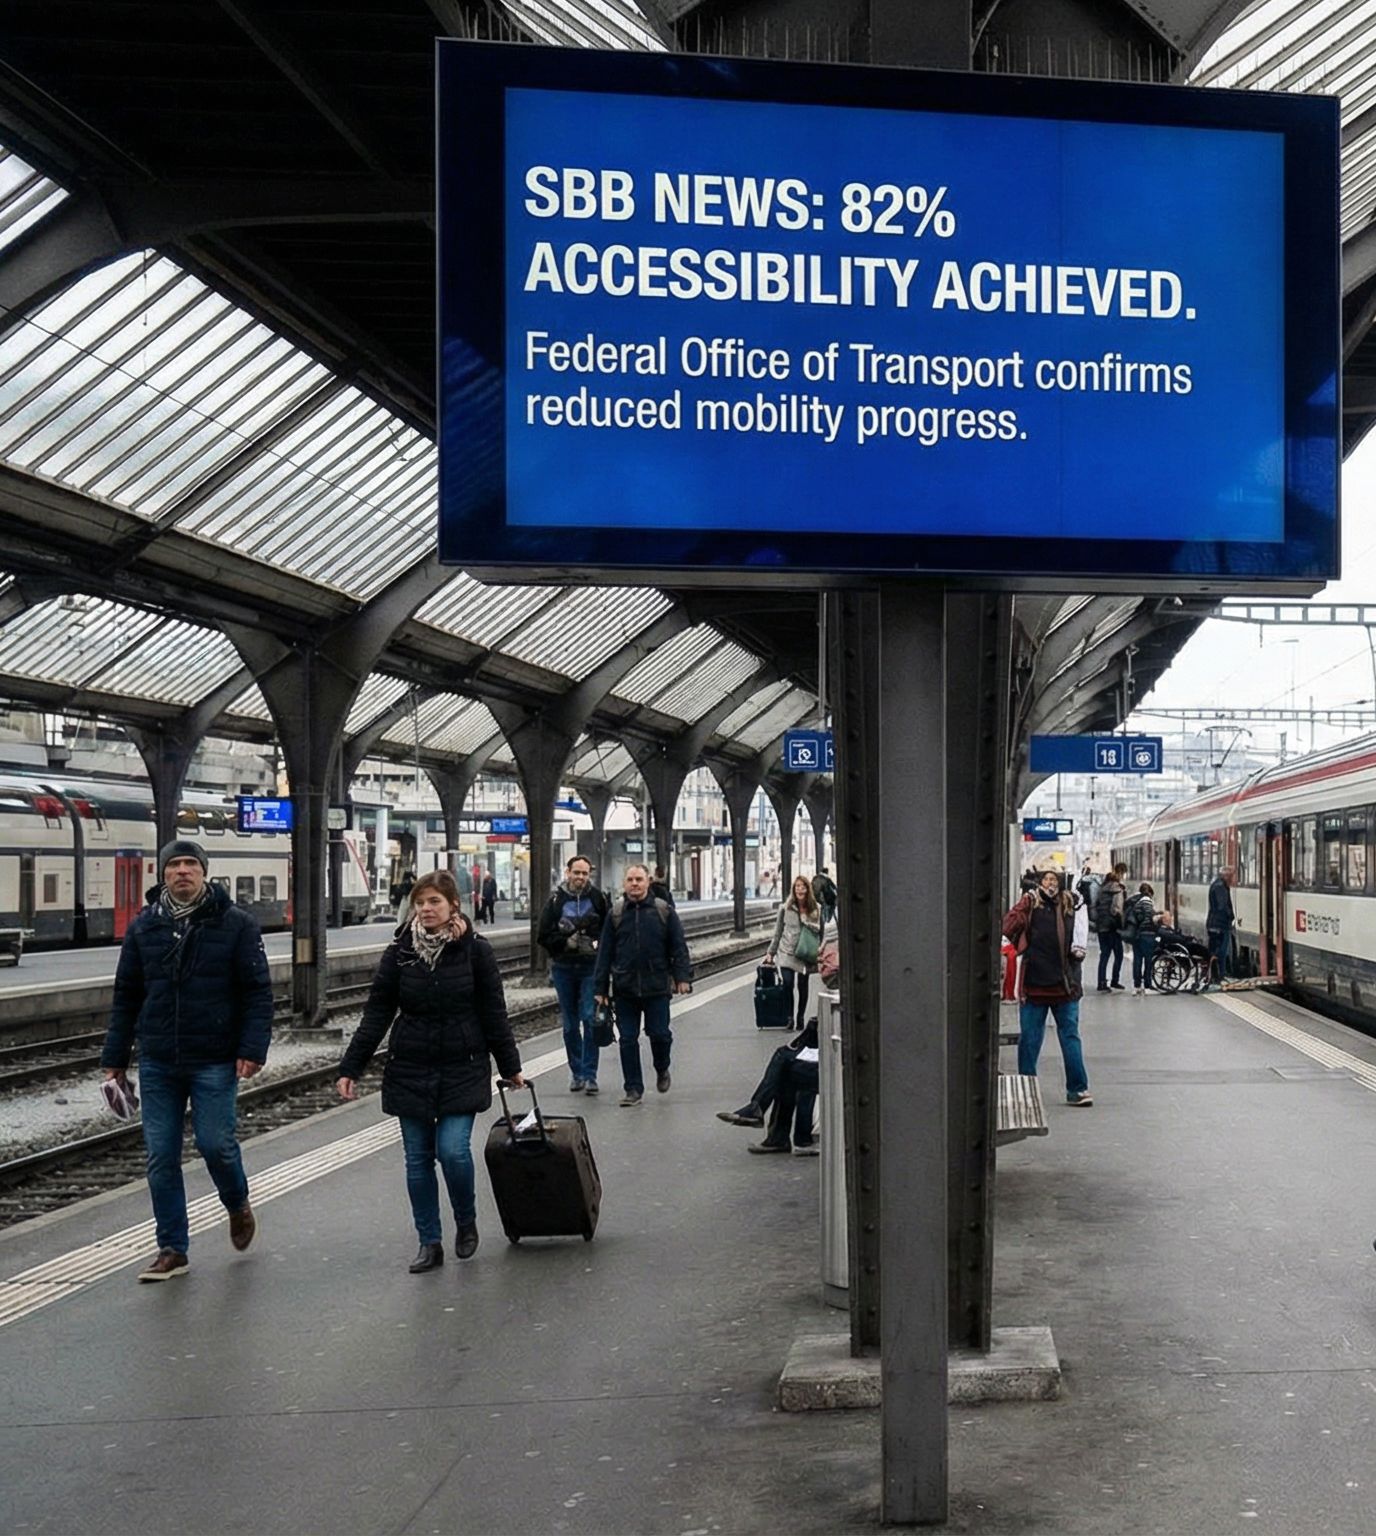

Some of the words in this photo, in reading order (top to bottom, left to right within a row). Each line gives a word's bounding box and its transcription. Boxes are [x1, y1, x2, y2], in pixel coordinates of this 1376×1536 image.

[525, 166, 634, 220] SBB
[655, 173, 823, 230] NEWS:
[841, 183, 955, 237] 82%
[525, 243, 919, 308] ACCESSIBILITY
[933, 262, 1196, 319] ACHIEVED.
[526, 331, 666, 375] Federal
[681, 337, 790, 380] Office
[803, 343, 840, 381] of
[849, 344, 1024, 390] Transport
[1035, 353, 1192, 393] confirms
[526, 387, 681, 430] reduced
[696, 395, 844, 442] mobility
[857, 406, 1027, 445] progress.
